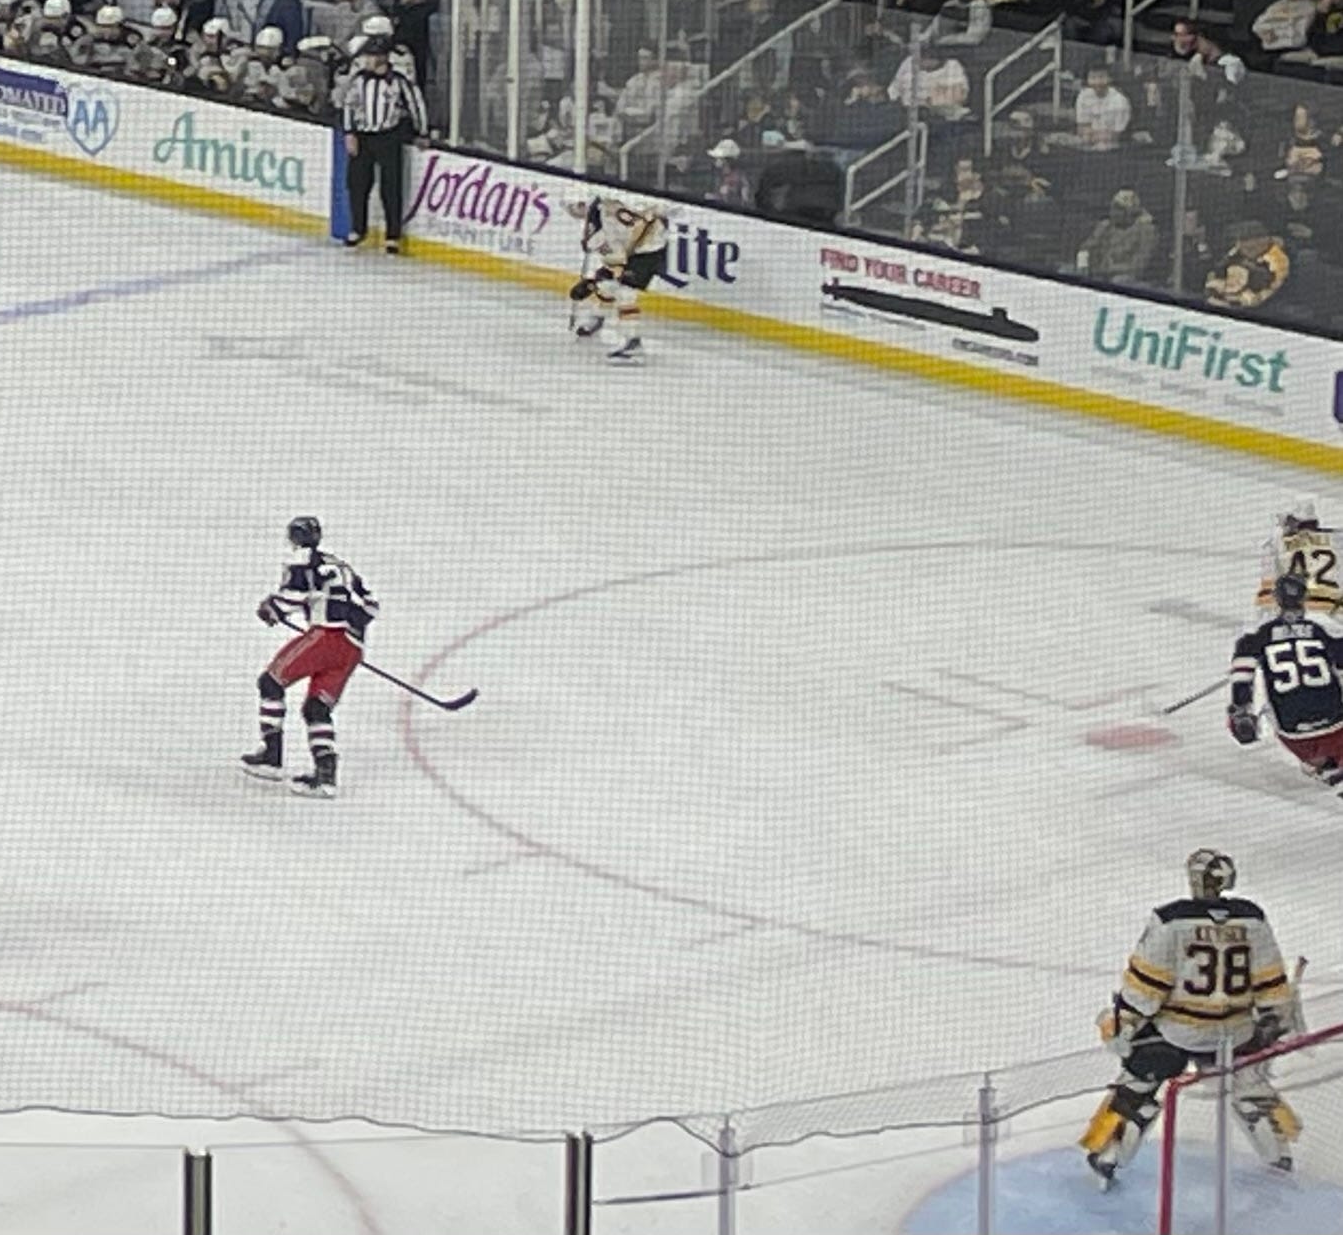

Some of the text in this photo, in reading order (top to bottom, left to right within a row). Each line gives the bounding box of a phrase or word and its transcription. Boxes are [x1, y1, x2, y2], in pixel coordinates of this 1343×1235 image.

[152, 111, 306, 196] Amica
[401, 155, 551, 235] Jordan's
[820, 248, 982, 299] FIND YOUR CAREER
[1092, 306, 1291, 393] UniFirst
[1286, 549, 1340, 589] 42
[1264, 639, 1332, 694] 55
[1183, 943, 1251, 997] 38
